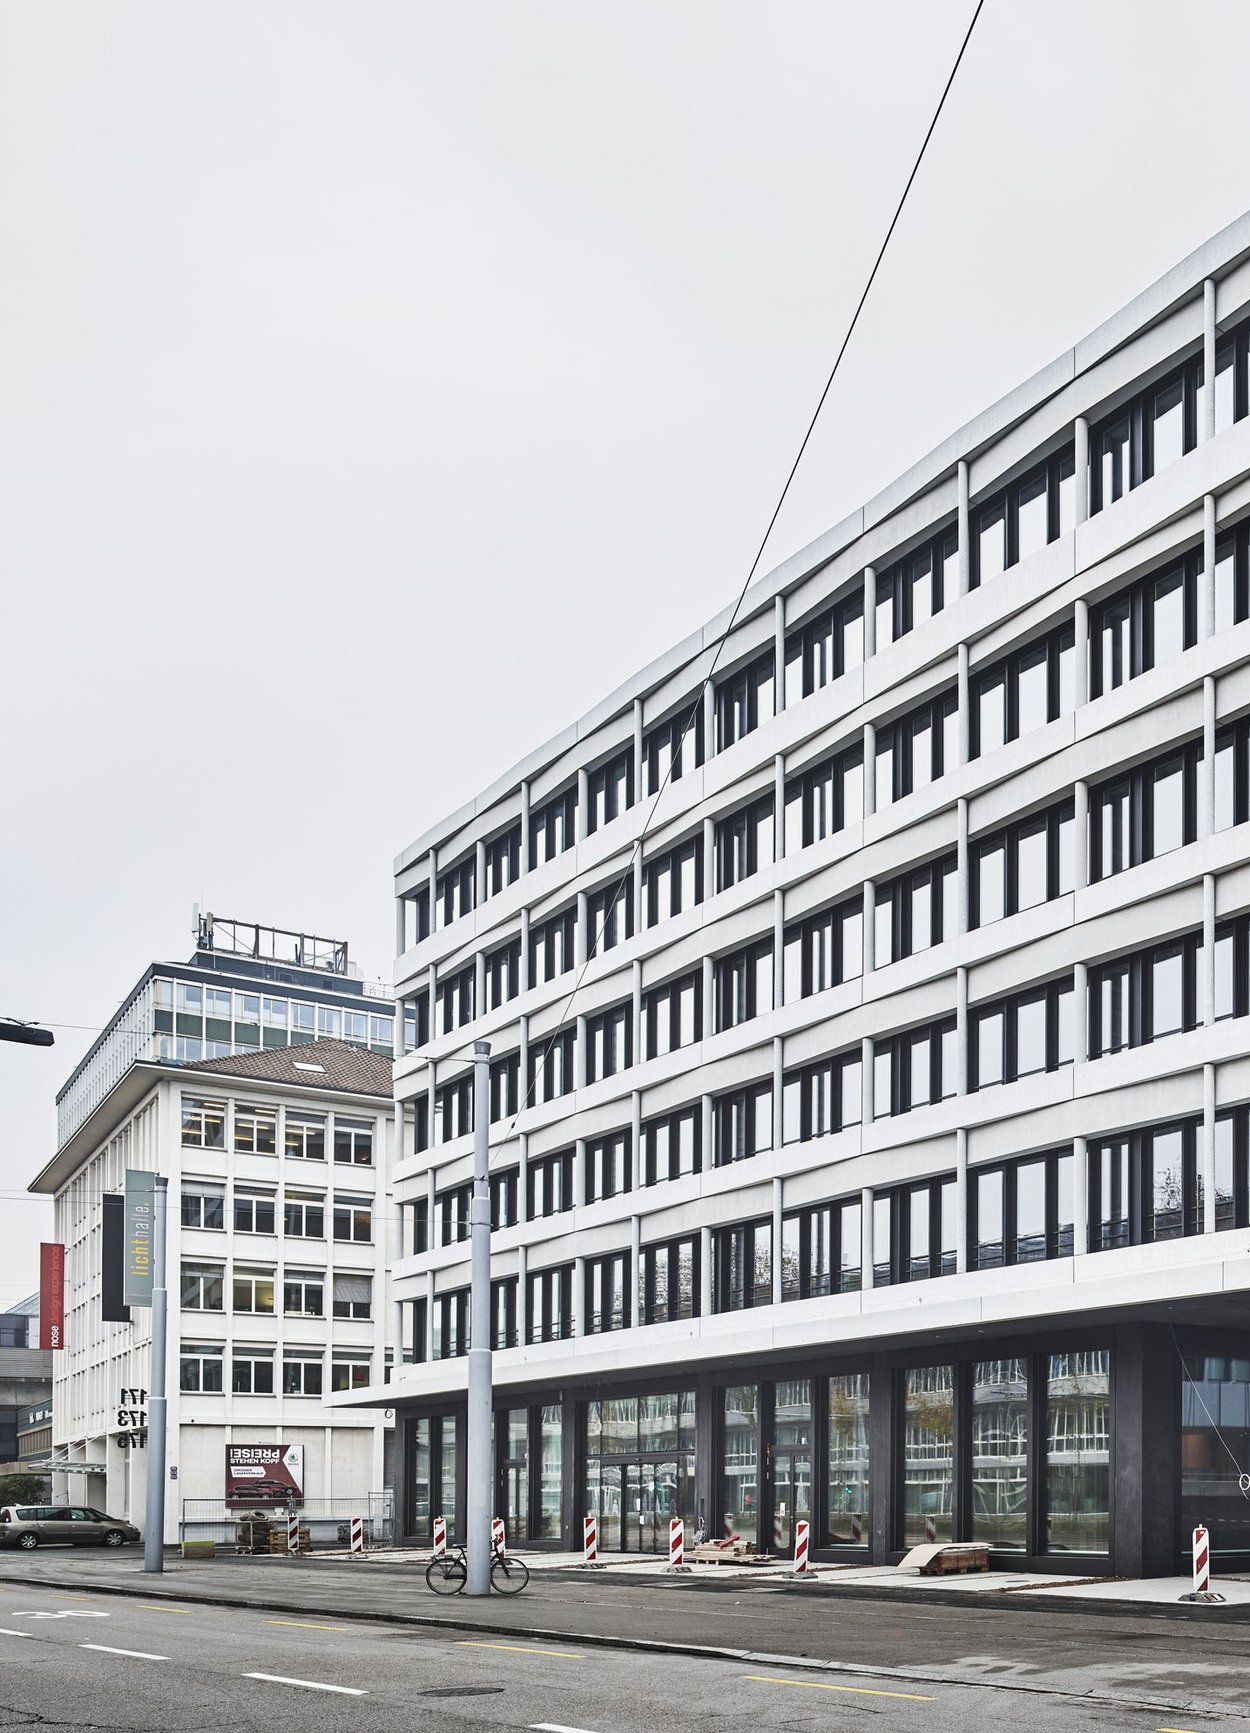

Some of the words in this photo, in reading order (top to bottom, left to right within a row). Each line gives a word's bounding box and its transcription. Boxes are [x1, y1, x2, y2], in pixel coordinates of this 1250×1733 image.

[50, 1247, 61, 1295] experience
[50, 1296, 61, 1324] design
[51, 1325, 59, 1347] nose
[12, 1610, 111, 1619] 30
